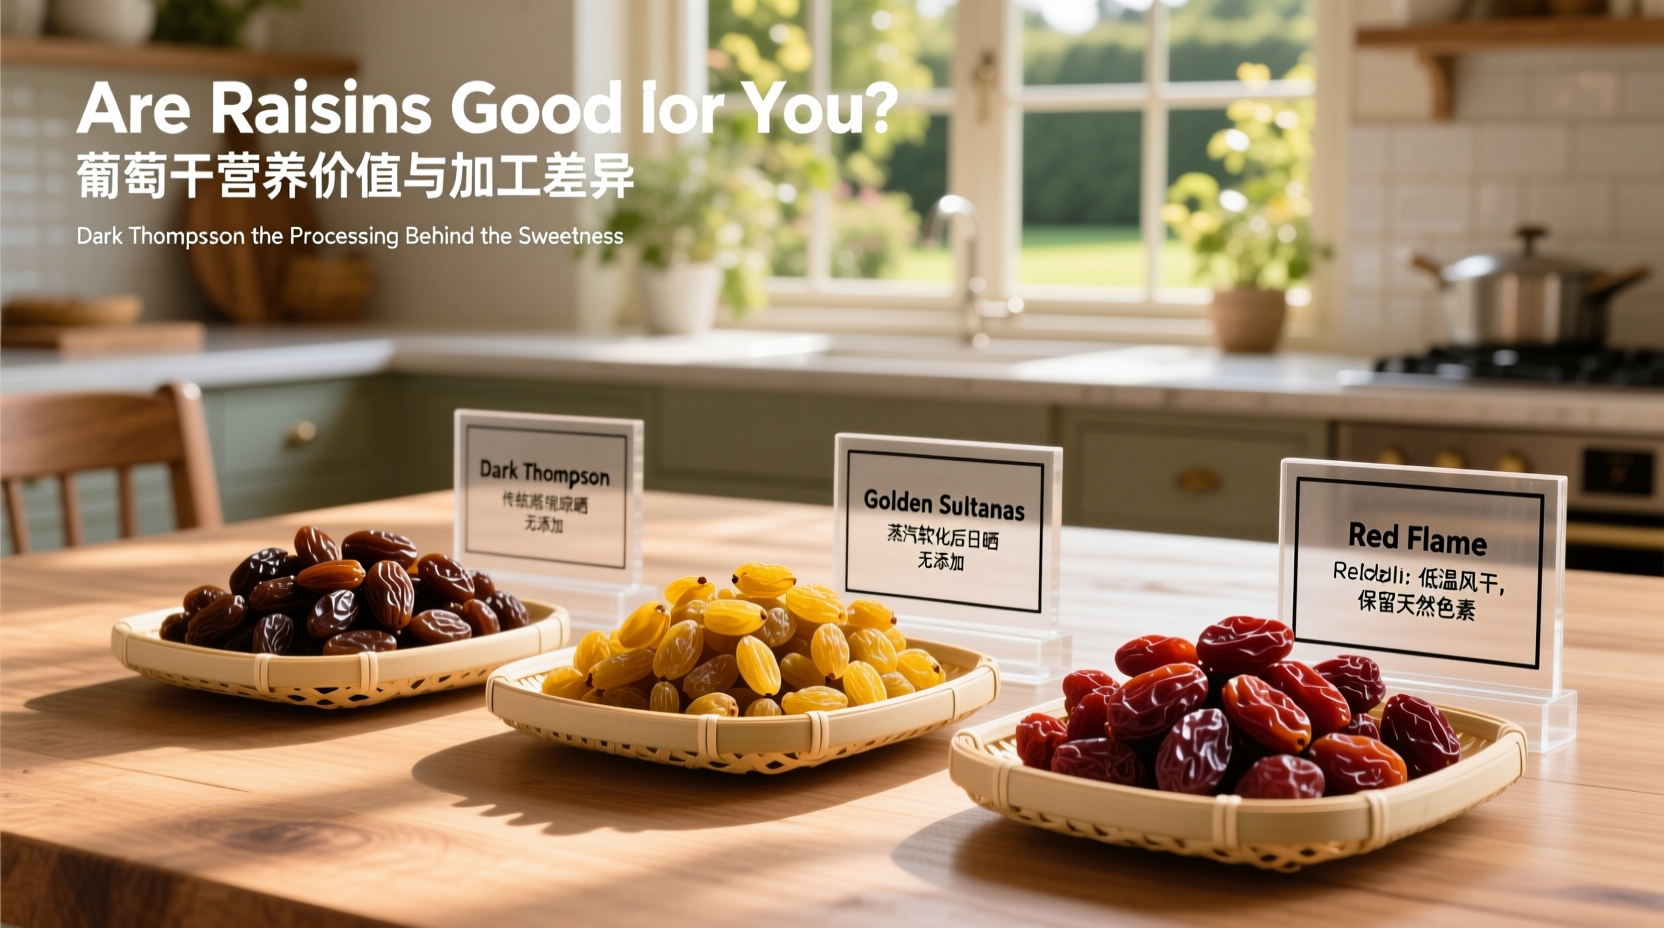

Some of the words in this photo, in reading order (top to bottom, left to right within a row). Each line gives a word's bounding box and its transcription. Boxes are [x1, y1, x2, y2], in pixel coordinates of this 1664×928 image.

[480, 458, 518, 480] Dark
[523, 462, 610, 490] Thompson
[864, 488, 933, 514] Golden
[939, 493, 1026, 522] Sultanas
[525, 513, 564, 533] 无添加
[887, 522, 1000, 552] 蒸汽软化后日晒
[1349, 521, 1399, 550] Red
[1407, 525, 1488, 557] Flame
[917, 550, 965, 572] 无添加
[1357, 588, 1477, 622] 保留天然色素
